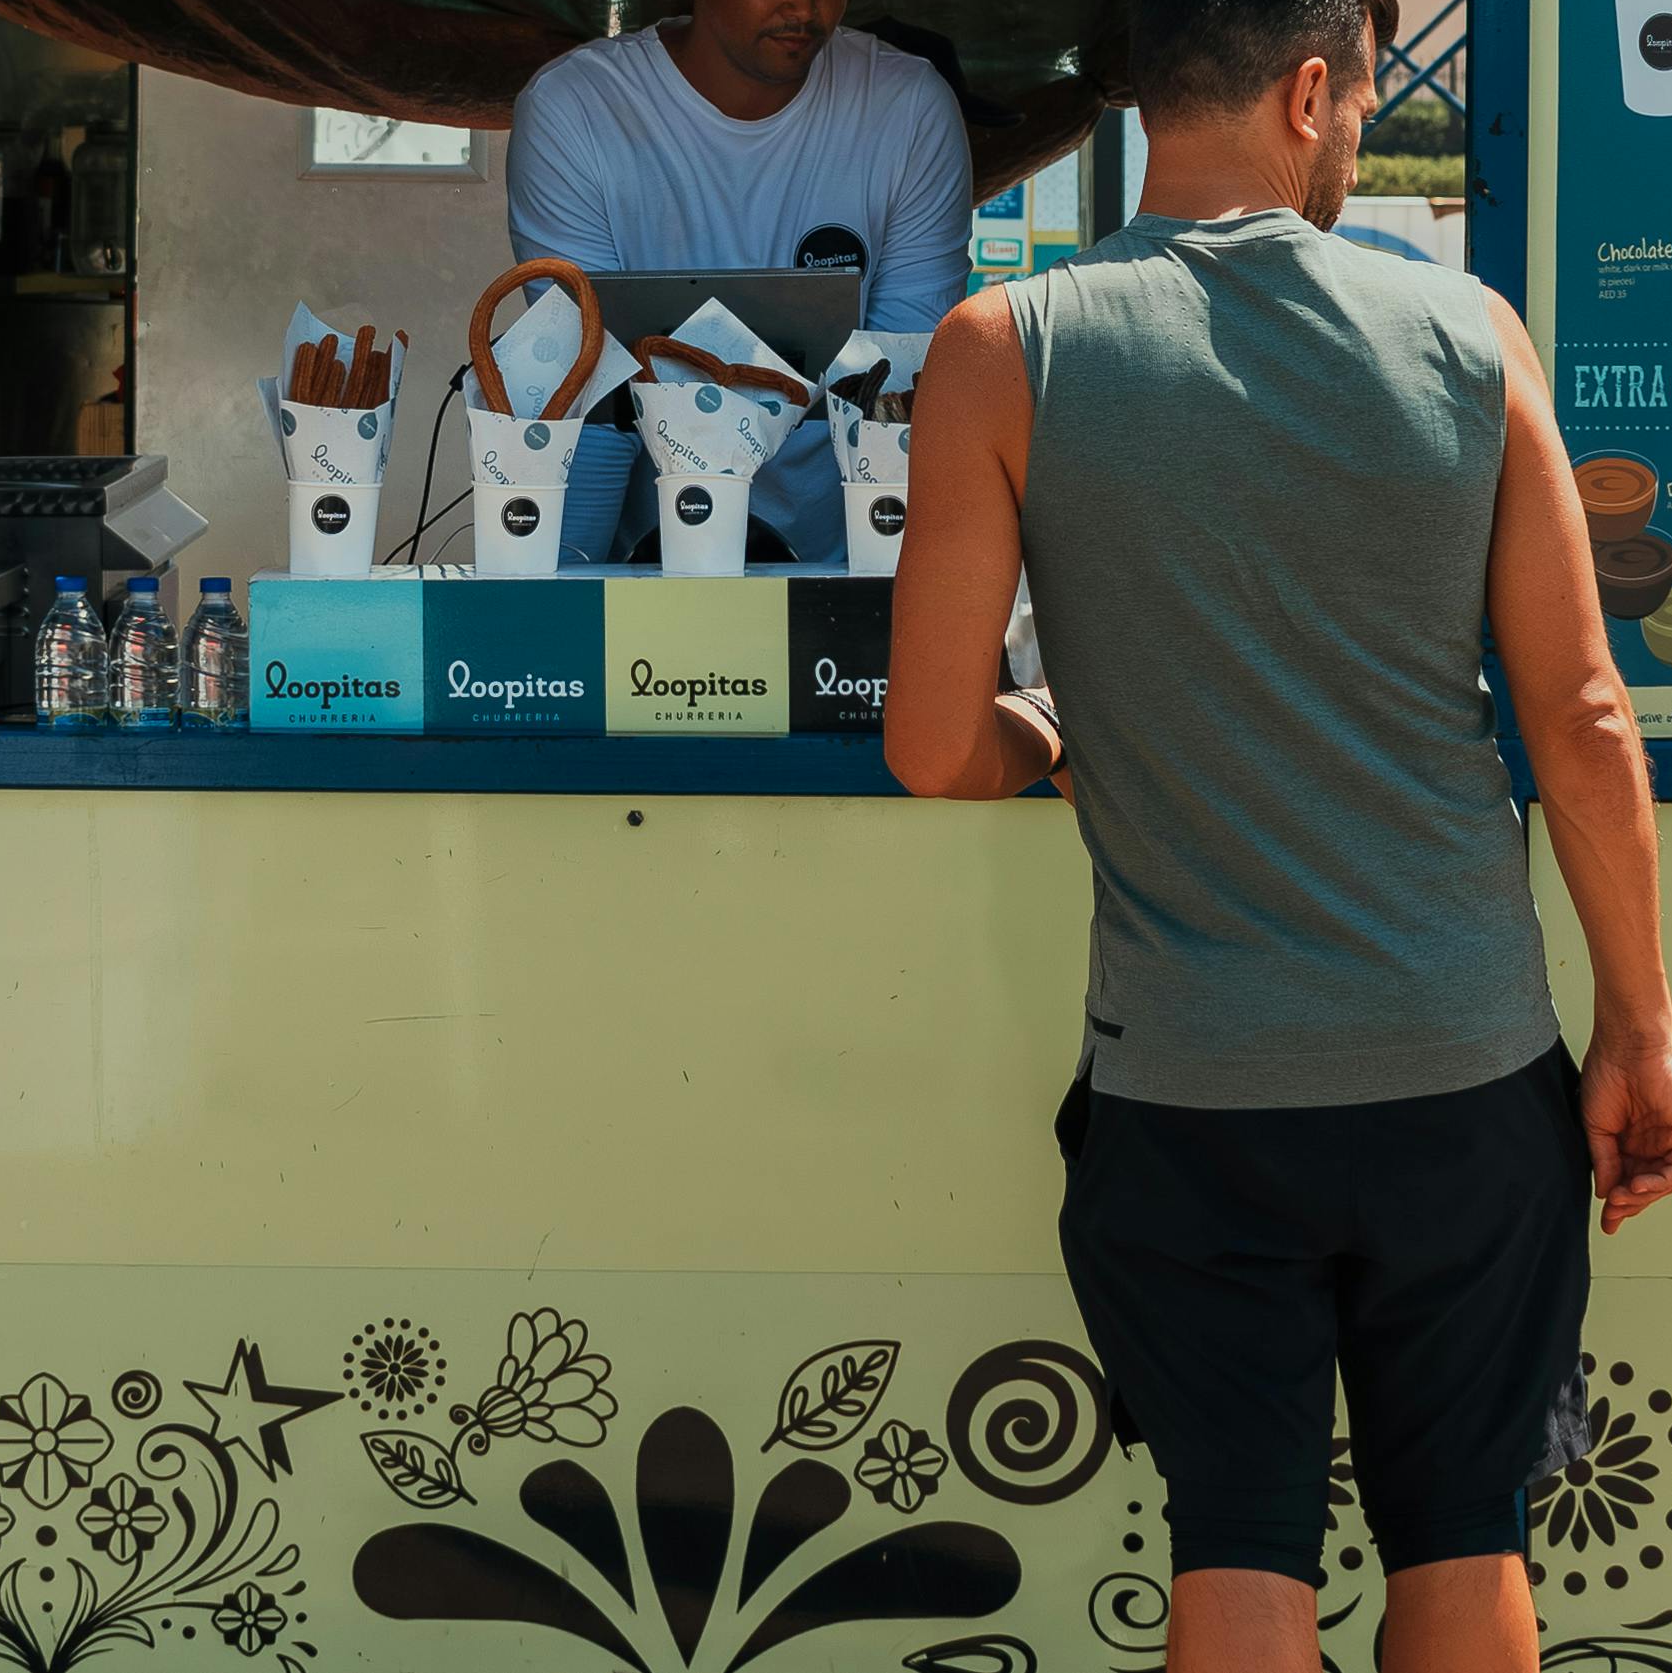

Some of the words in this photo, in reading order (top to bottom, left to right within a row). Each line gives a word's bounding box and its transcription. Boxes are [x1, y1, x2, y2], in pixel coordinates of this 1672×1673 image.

[804, 252, 858, 268] loopitas
[1598, 238, 1672, 261] Chocolate
[1575, 365, 1667, 407] EXTRA
[266, 661, 400, 709] loopitas
[449, 661, 584, 708] loopitas
[631, 659, 767, 707] loopitas
[815, 658, 888, 706] loop
[289, 714, 375, 723] CHURRERIA
[473, 713, 559, 721] CHURRERIA
[655, 712, 742, 720] CHURRERIA
